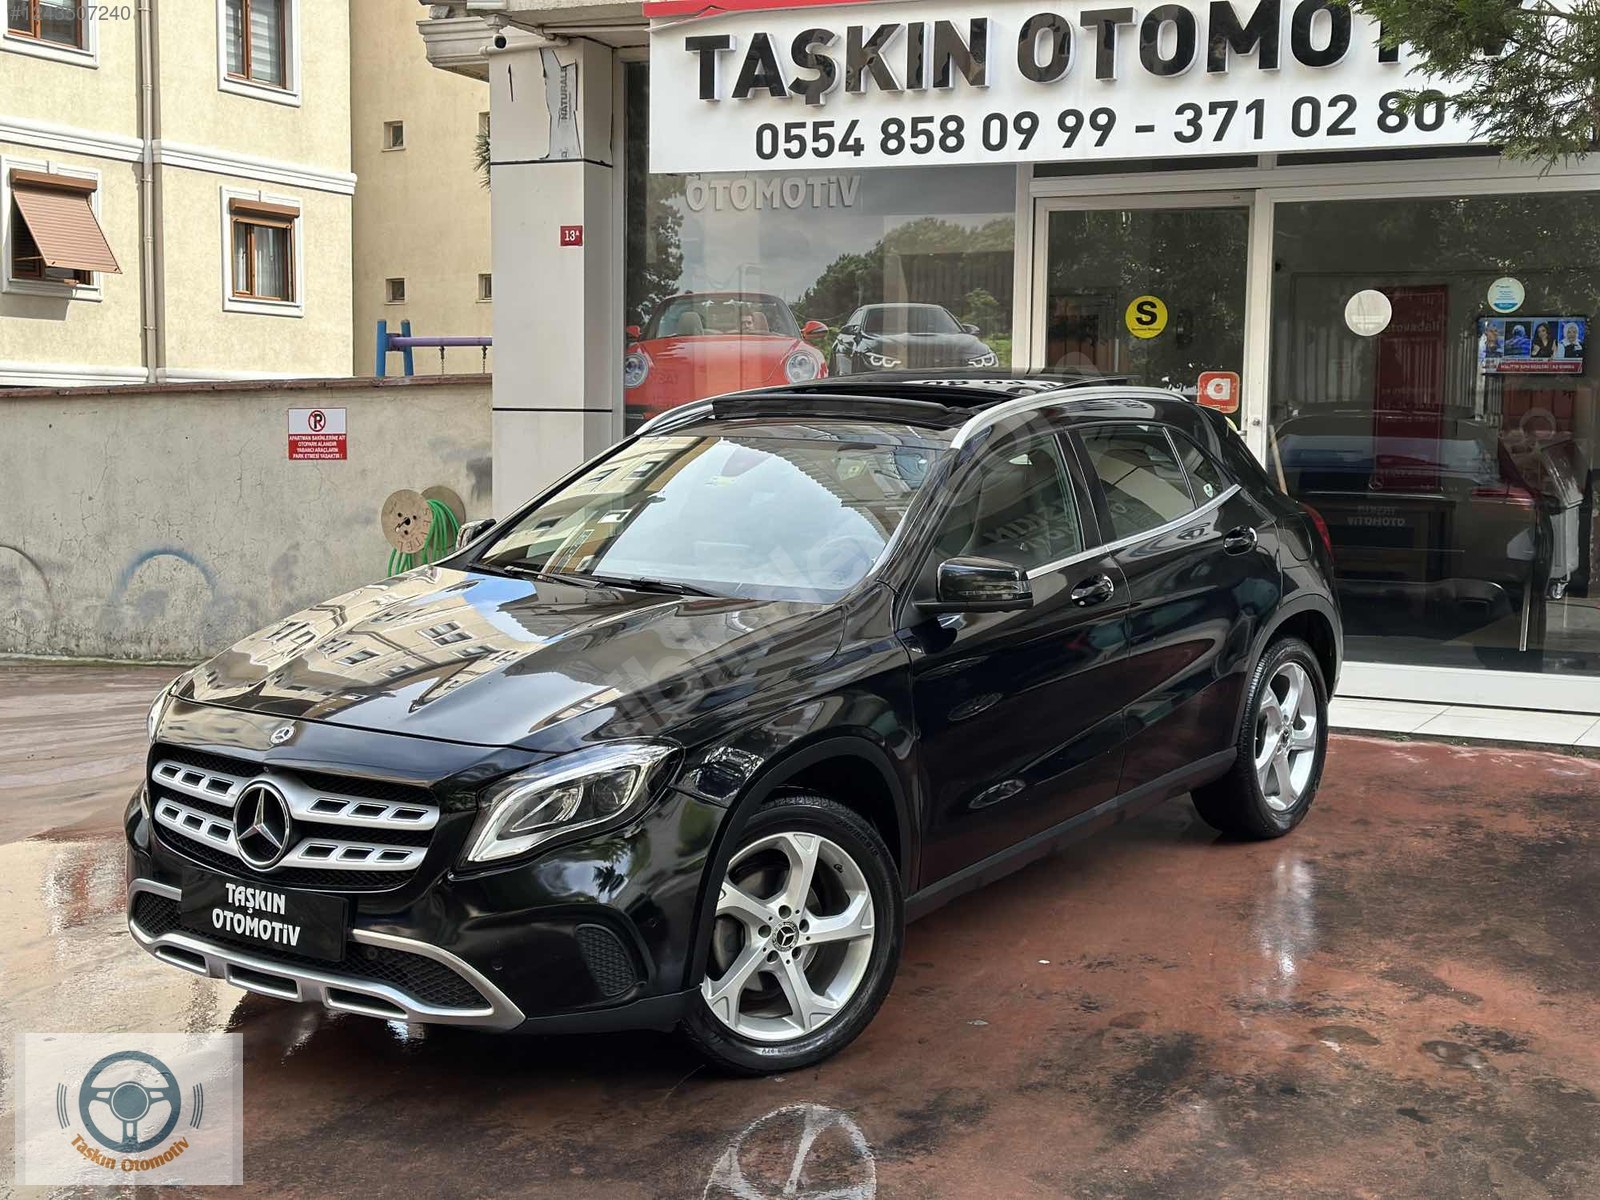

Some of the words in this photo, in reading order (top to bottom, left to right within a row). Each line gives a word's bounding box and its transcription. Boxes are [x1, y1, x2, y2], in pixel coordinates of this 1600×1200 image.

[685, 16, 992, 107] TAŞKIN
[755, 119, 865, 160] 0554
[880, 114, 966, 156] 858
[982, 110, 1040, 151] 09
[1057, 107, 1117, 149] 99
[1173, 98, 1266, 144] 371
[1291, 94, 1358, 138] 02
[1376, 89, 1445, 134] 80
[1135, 300, 1158, 326] S
[225, 882, 286, 914] TAŞKIN
